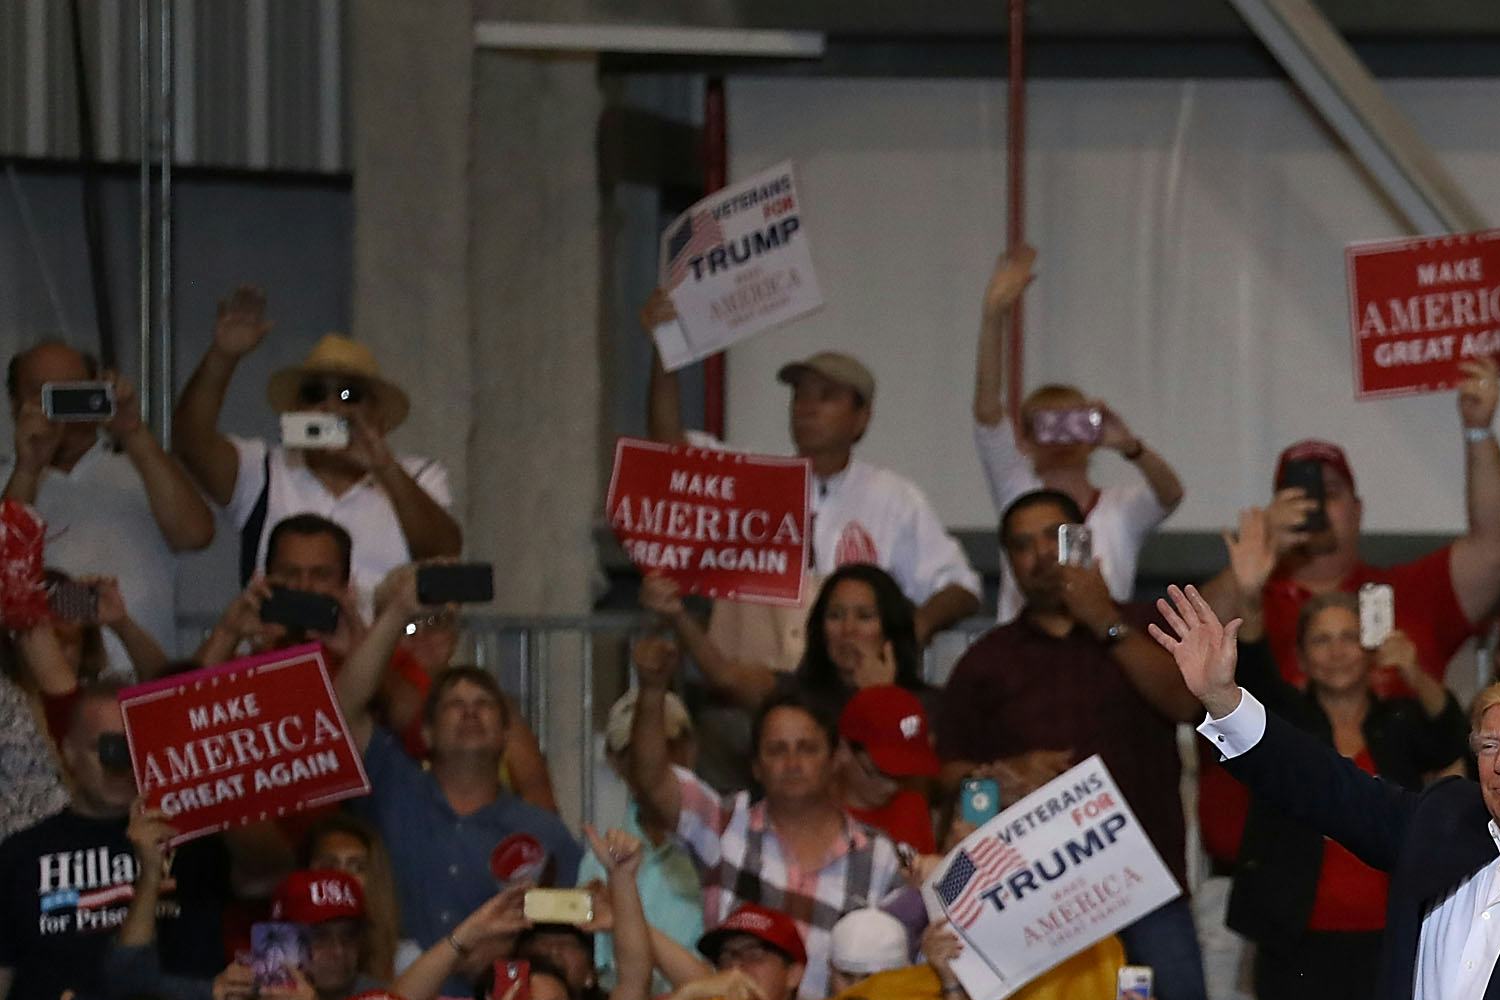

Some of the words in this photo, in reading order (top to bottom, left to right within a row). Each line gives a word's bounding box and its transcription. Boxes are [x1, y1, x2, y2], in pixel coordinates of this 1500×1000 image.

[688, 216, 800, 281] TRUMP
[1416, 257, 1483, 286] MAKE
[1373, 335, 1455, 368] GREAT
[669, 469, 736, 500] MAKE
[612, 495, 800, 545] AMERICA
[700, 547, 788, 575] AGAIN
[188, 693, 260, 731] MAKE
[142, 709, 342, 790] AMERICA
[160, 774, 245, 817] GREAT
[253, 750, 340, 793] AGAIN
[997, 772, 1105, 847] VETERANS
[1071, 792, 1116, 827] FOR
[980, 813, 1127, 913] TRUMP
[309, 879, 358, 908] USA
[39, 911, 71, 936] for
